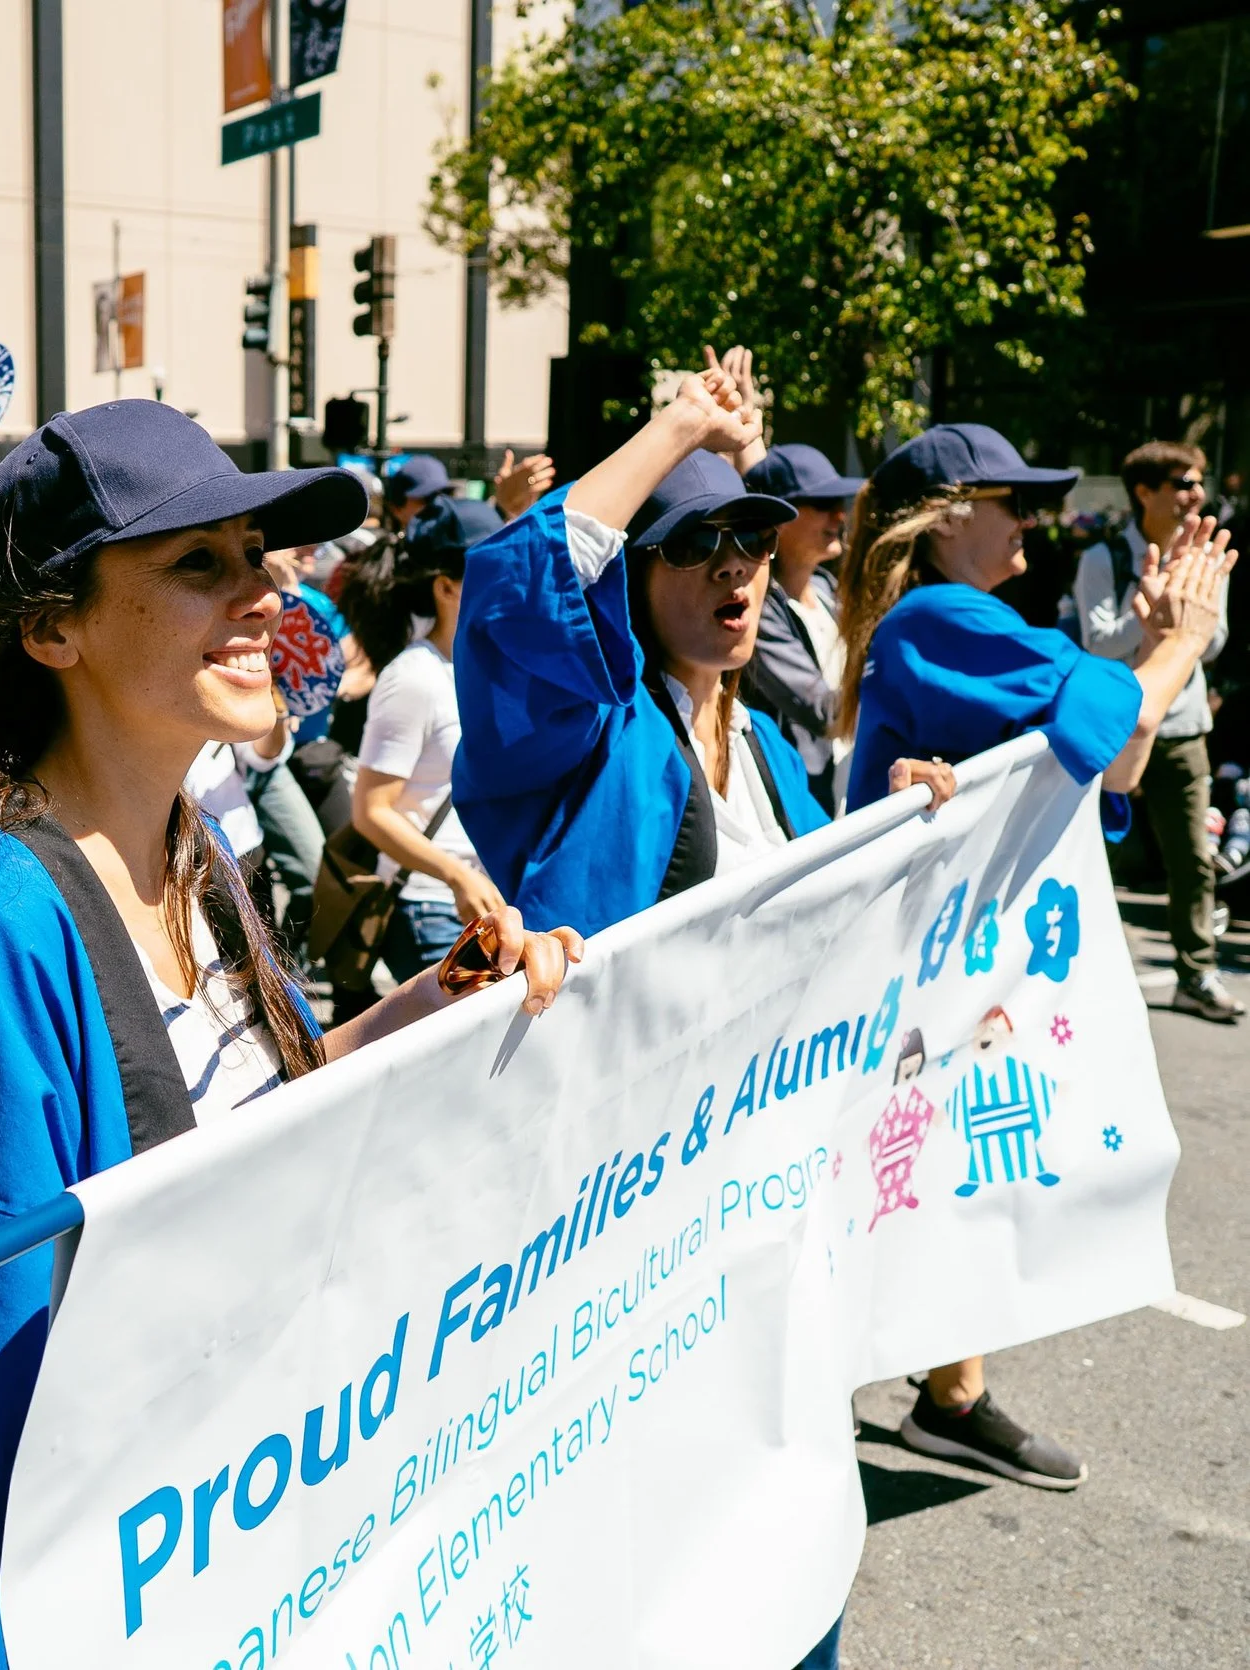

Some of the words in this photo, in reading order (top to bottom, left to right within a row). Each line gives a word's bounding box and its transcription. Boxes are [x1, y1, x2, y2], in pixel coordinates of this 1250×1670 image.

[241, 110, 296, 149] Post
[117, 1312, 411, 1640] Proud
[426, 1130, 672, 1384] Families
[679, 1083, 716, 1167] &
[212, 1513, 378, 1670] anese
[389, 1324, 558, 1528] Bilingual
[571, 1195, 710, 1361] Bicultural
[345, 1611, 411, 1670] on
[417, 1385, 617, 1627] Elementary
[627, 1273, 727, 1403] School
[450, 1564, 533, 1670] 学校
